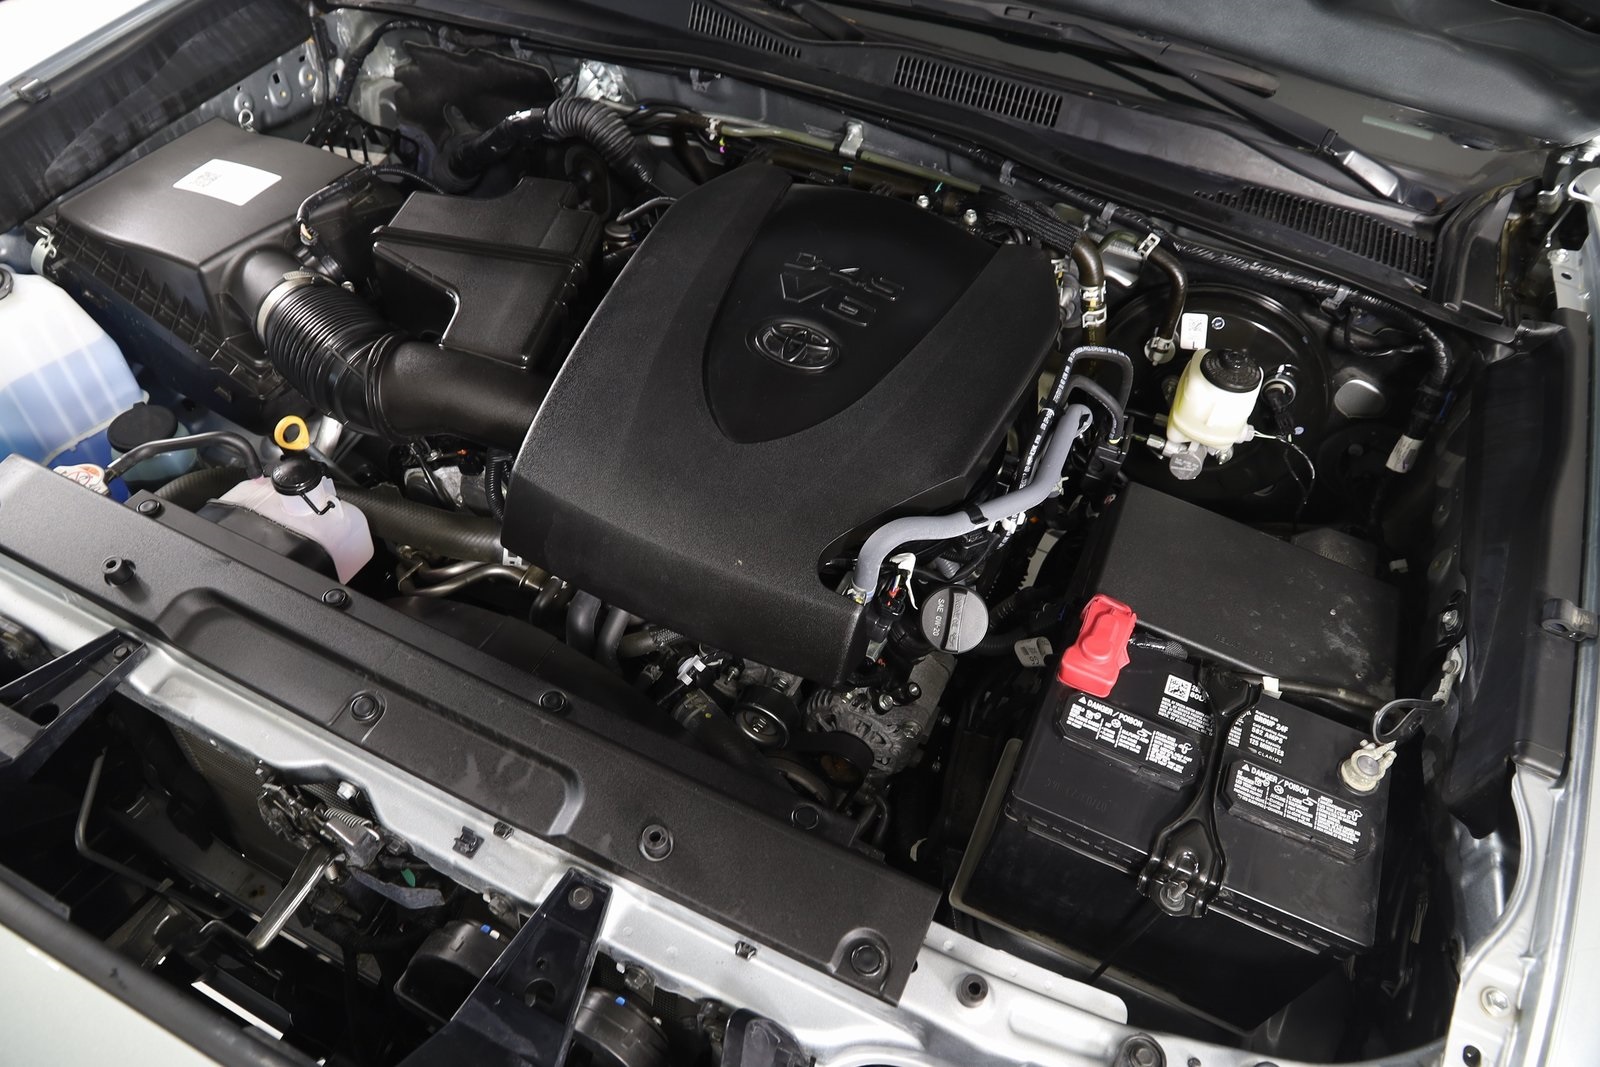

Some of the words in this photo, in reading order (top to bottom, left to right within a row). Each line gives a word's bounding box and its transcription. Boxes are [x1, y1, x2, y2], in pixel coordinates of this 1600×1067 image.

[936, 598, 945, 613] SAE
[1087, 699, 1114, 716] DANGER
[1118, 713, 1144, 728] POISON
[1254, 714, 1276, 727] GROUP
[1264, 732, 1283, 744] AMPS
[1259, 742, 1285, 757] MINUTES
[1257, 751, 1282, 764] CLARIOS
[1251, 767, 1278, 783] DANGER
[1284, 781, 1309, 796] POISON
